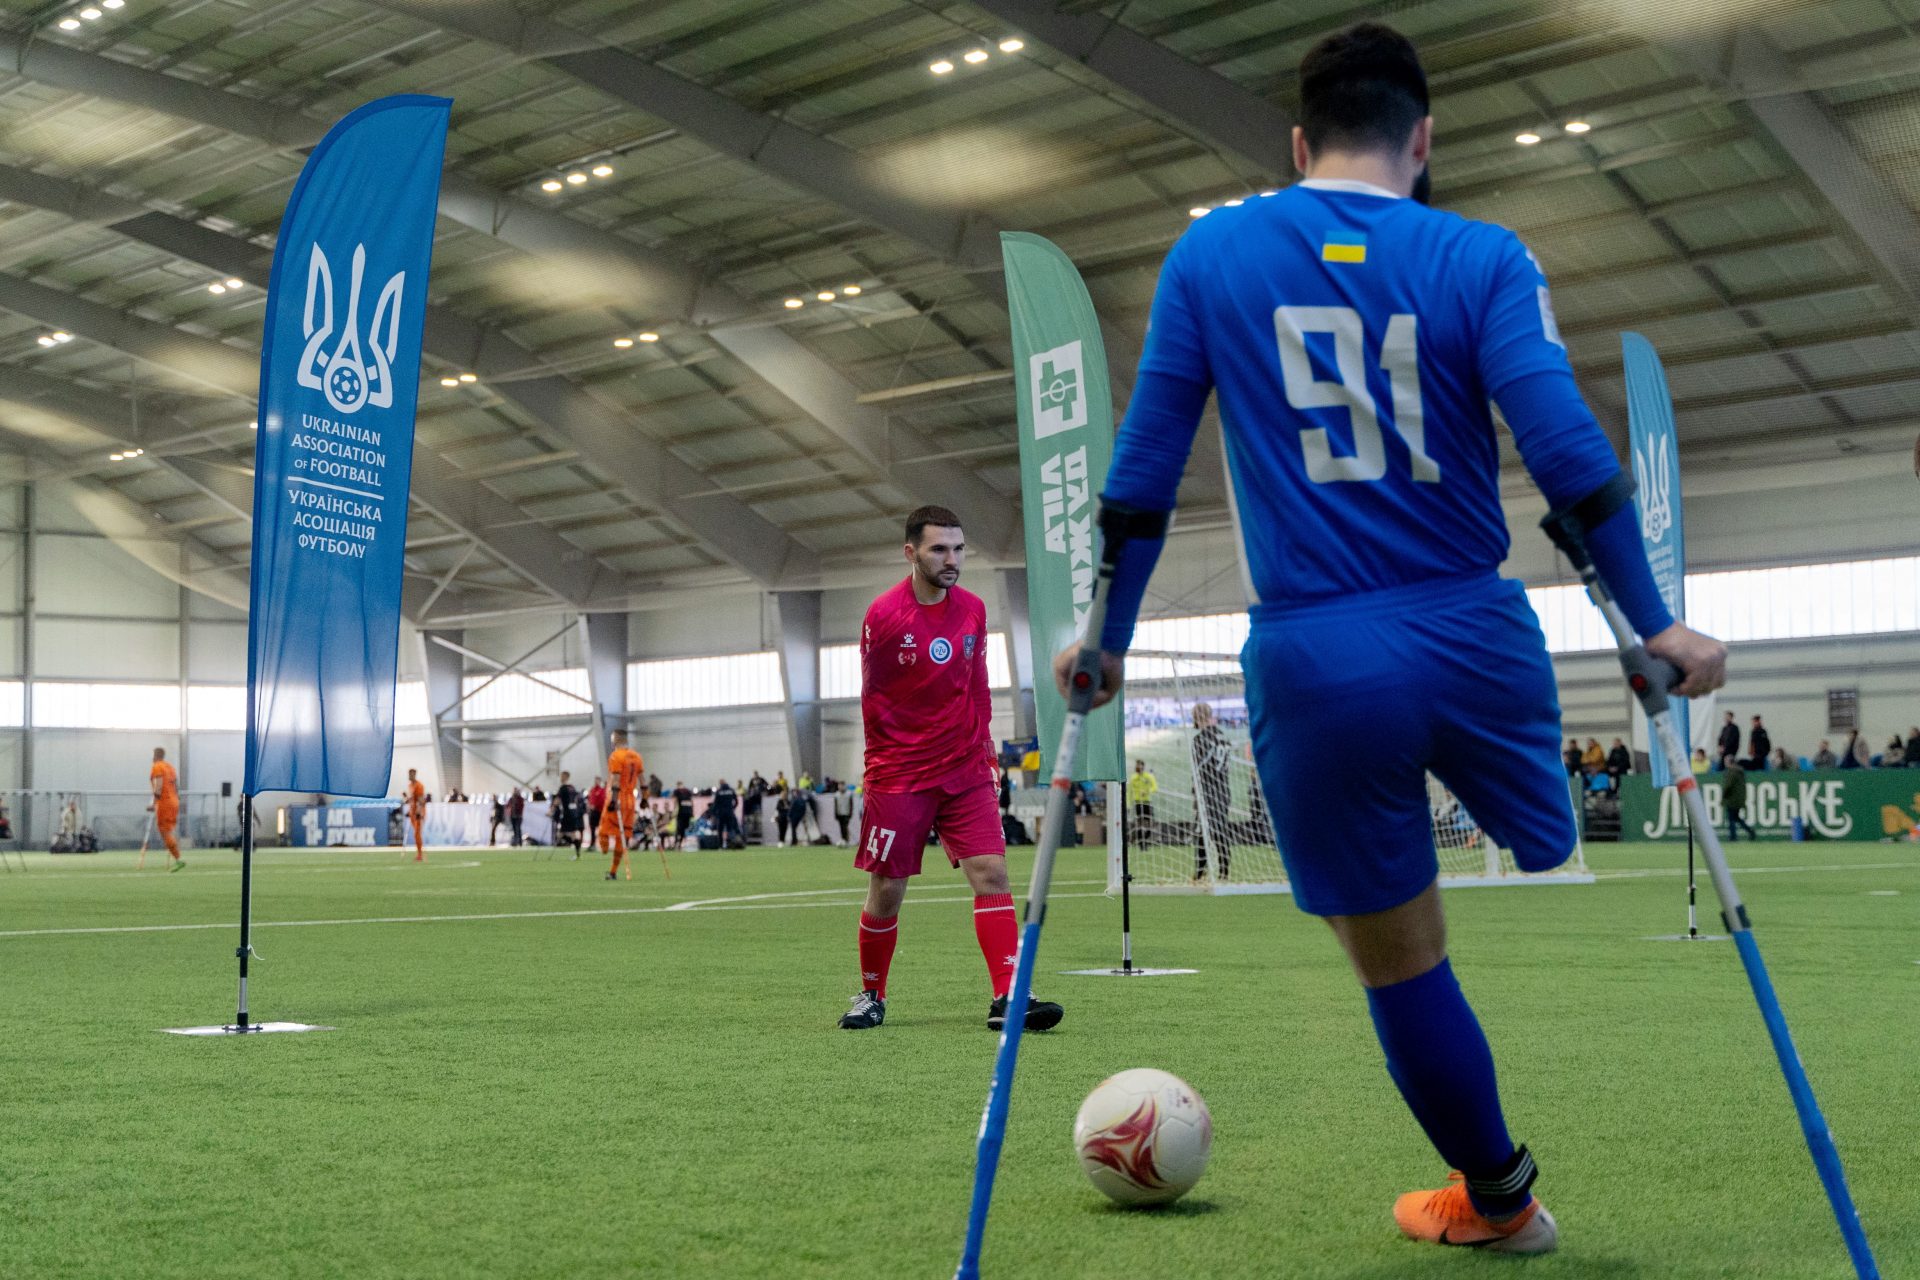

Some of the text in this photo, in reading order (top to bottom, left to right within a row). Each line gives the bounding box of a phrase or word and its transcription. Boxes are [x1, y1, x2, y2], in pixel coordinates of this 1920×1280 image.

[1273, 304, 1441, 484] 91
[302, 414, 381, 447] UKRAINIAN
[291, 434, 386, 468] ASSOCIATION
[294, 458, 382, 487] OF FOOTBALL
[288, 489, 382, 522] УКРАЇНСЬКА
[293, 511, 376, 541] АСОЦІАЦІЯ
[298, 534, 366, 559] ФУТБОЛУ
[866, 825, 896, 863] 47
